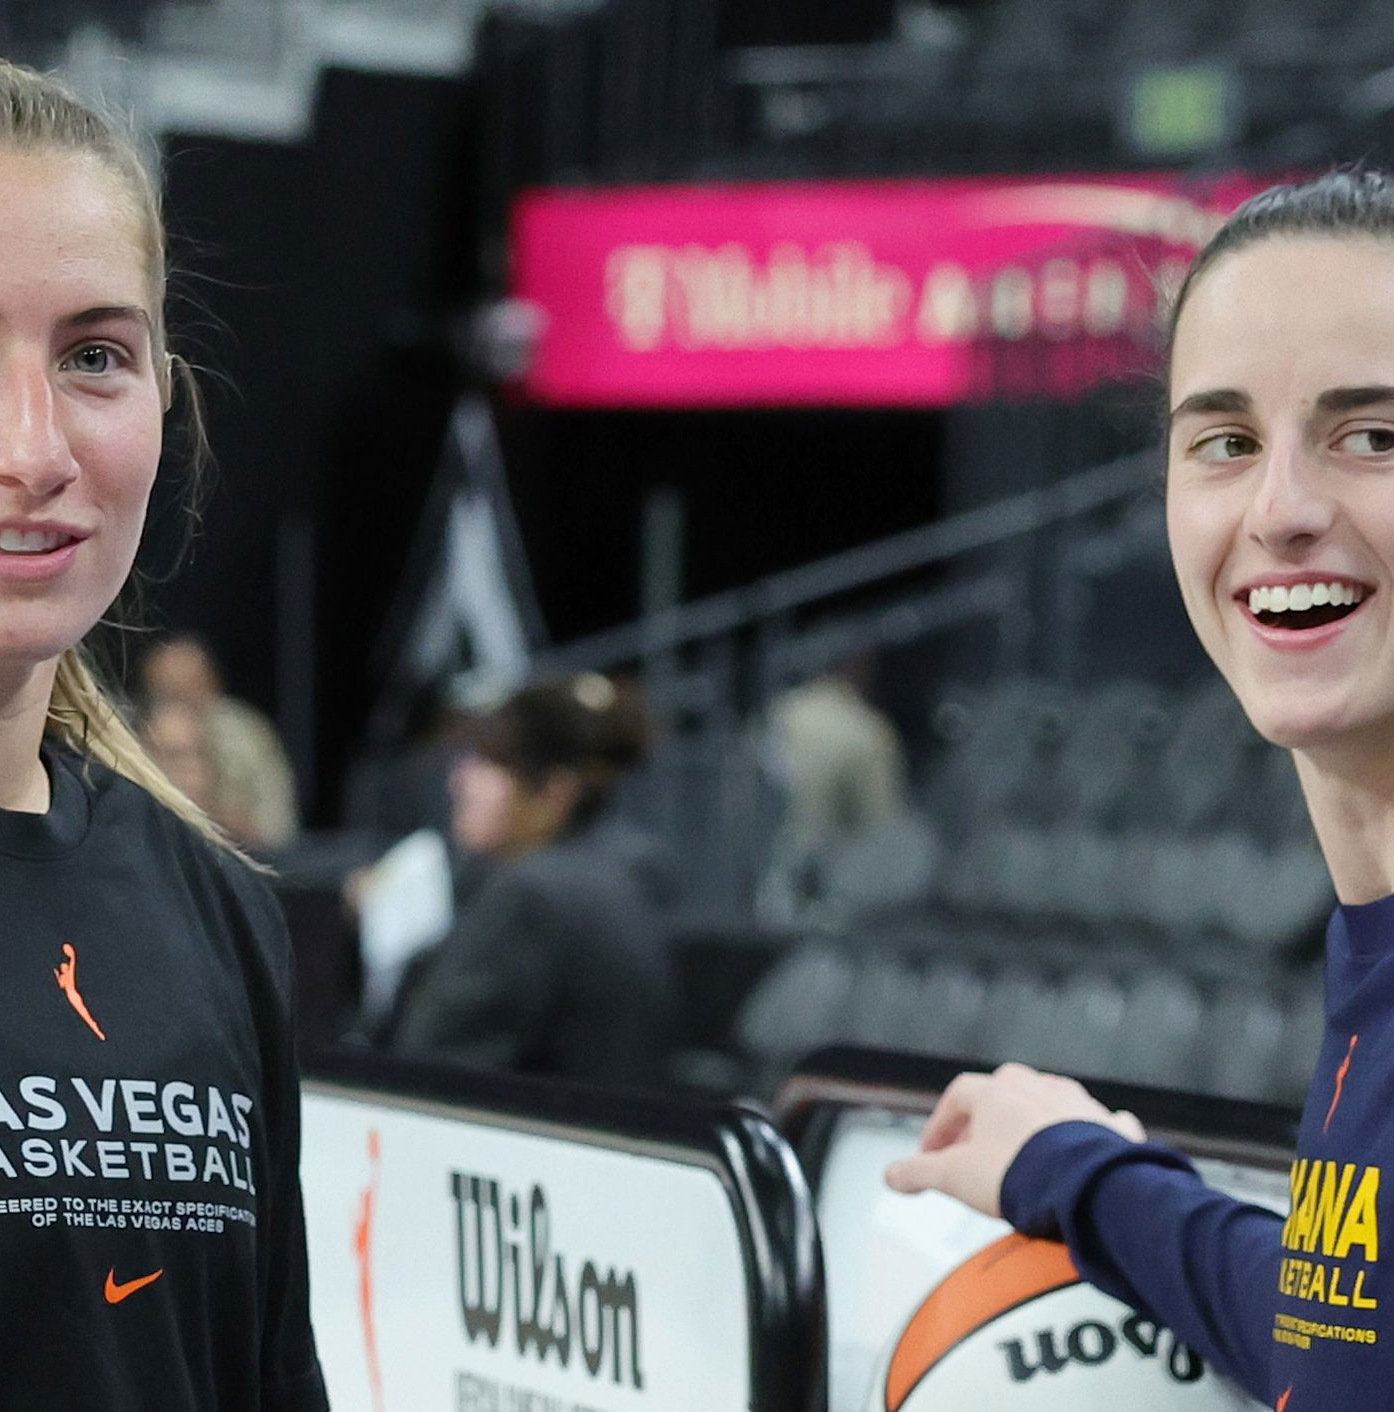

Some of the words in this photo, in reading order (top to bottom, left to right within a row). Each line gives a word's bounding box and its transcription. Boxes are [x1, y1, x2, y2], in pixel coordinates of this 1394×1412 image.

[71, 1077, 253, 1149] VEGAS
[31, 1212, 58, 1228] OF
[62, 1211, 94, 1227] THE
[96, 1213, 127, 1229] LAS
[131, 1214, 182, 1231] VEGAS
[185, 1217, 225, 1234] ACES
[62, 1196, 85, 1212] TO
[87, 1198, 118, 1213] THE
[121, 1199, 170, 1216] EXACT
[450, 1171, 644, 1389] Wilson
